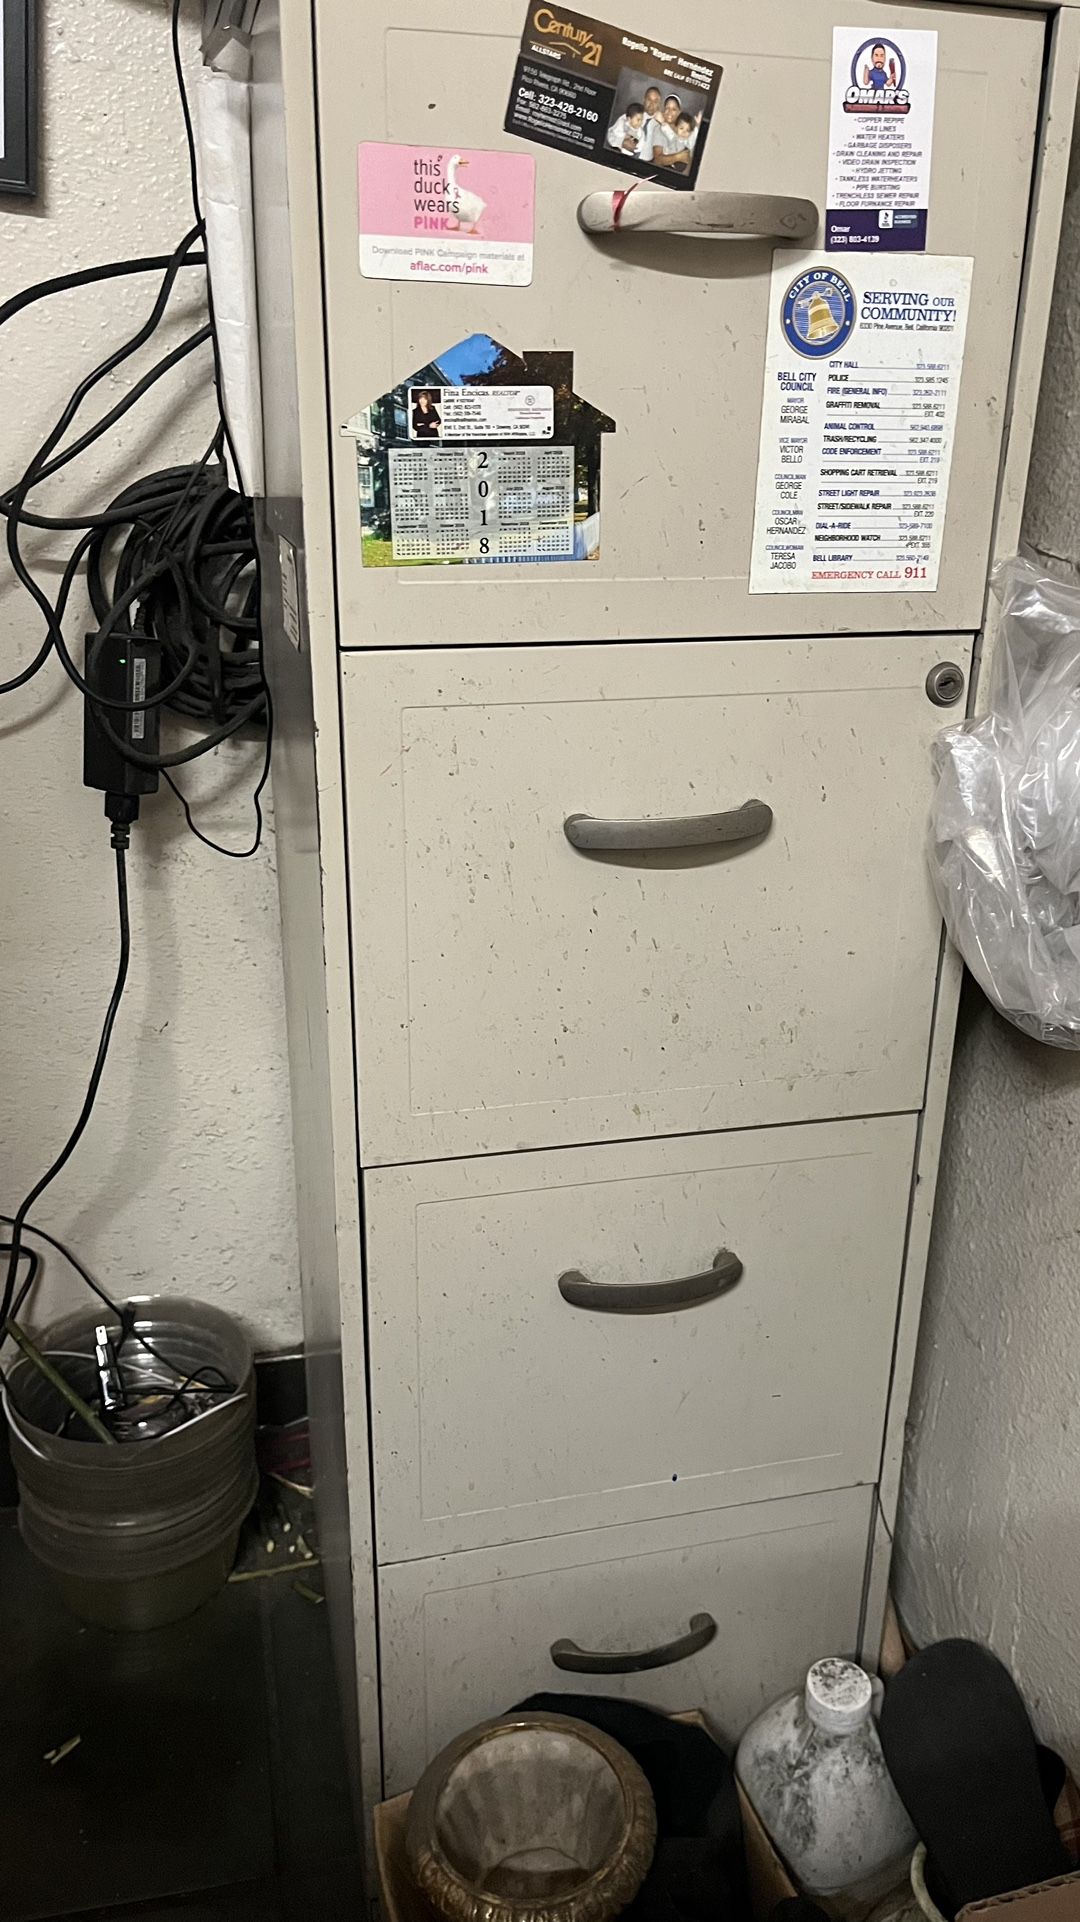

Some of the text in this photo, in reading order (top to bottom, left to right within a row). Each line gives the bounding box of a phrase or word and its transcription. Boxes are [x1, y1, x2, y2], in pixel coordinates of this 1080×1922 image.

[533, 9, 603, 66] Century 21
[845, 85, 910, 105] OMAR'S
[518, 87, 536, 101] Cell:
[538, 94, 599, 122] 323-428-2160
[414, 159, 441, 177] this
[414, 177, 450, 195] duck
[414, 198, 460, 214] wears
[414, 215, 449, 231] PINK
[372, 245, 525, 261] Download PINK Campaign materials at
[410, 260, 488, 275] aflac.com/pink
[788, 272, 851, 303] CITY OF BELL
[863, 291, 955, 307] SERVING OUR
[861, 307, 957, 322] COMMUNITY!
[843, 361, 859, 369] HALL
[777, 372, 817, 382] BELL CITY
[780, 382, 814, 391] COUNCIL
[842, 387, 870, 395] (GENERAL
[872, 388, 887, 396] INFO)
[781, 406, 808, 414] GEORGE
[826, 401, 852, 409] GRAFFITI
[780, 416, 809, 424] MIRABAL
[779, 445, 803, 453] VICTOR
[781, 455, 803, 463] BELLO
[780, 491, 798, 499] COLE
[775, 517, 797, 525] OSCAR
[771, 552, 795, 560] TERESA
[811, 567, 927, 580] EMERGENCY CALL 911
